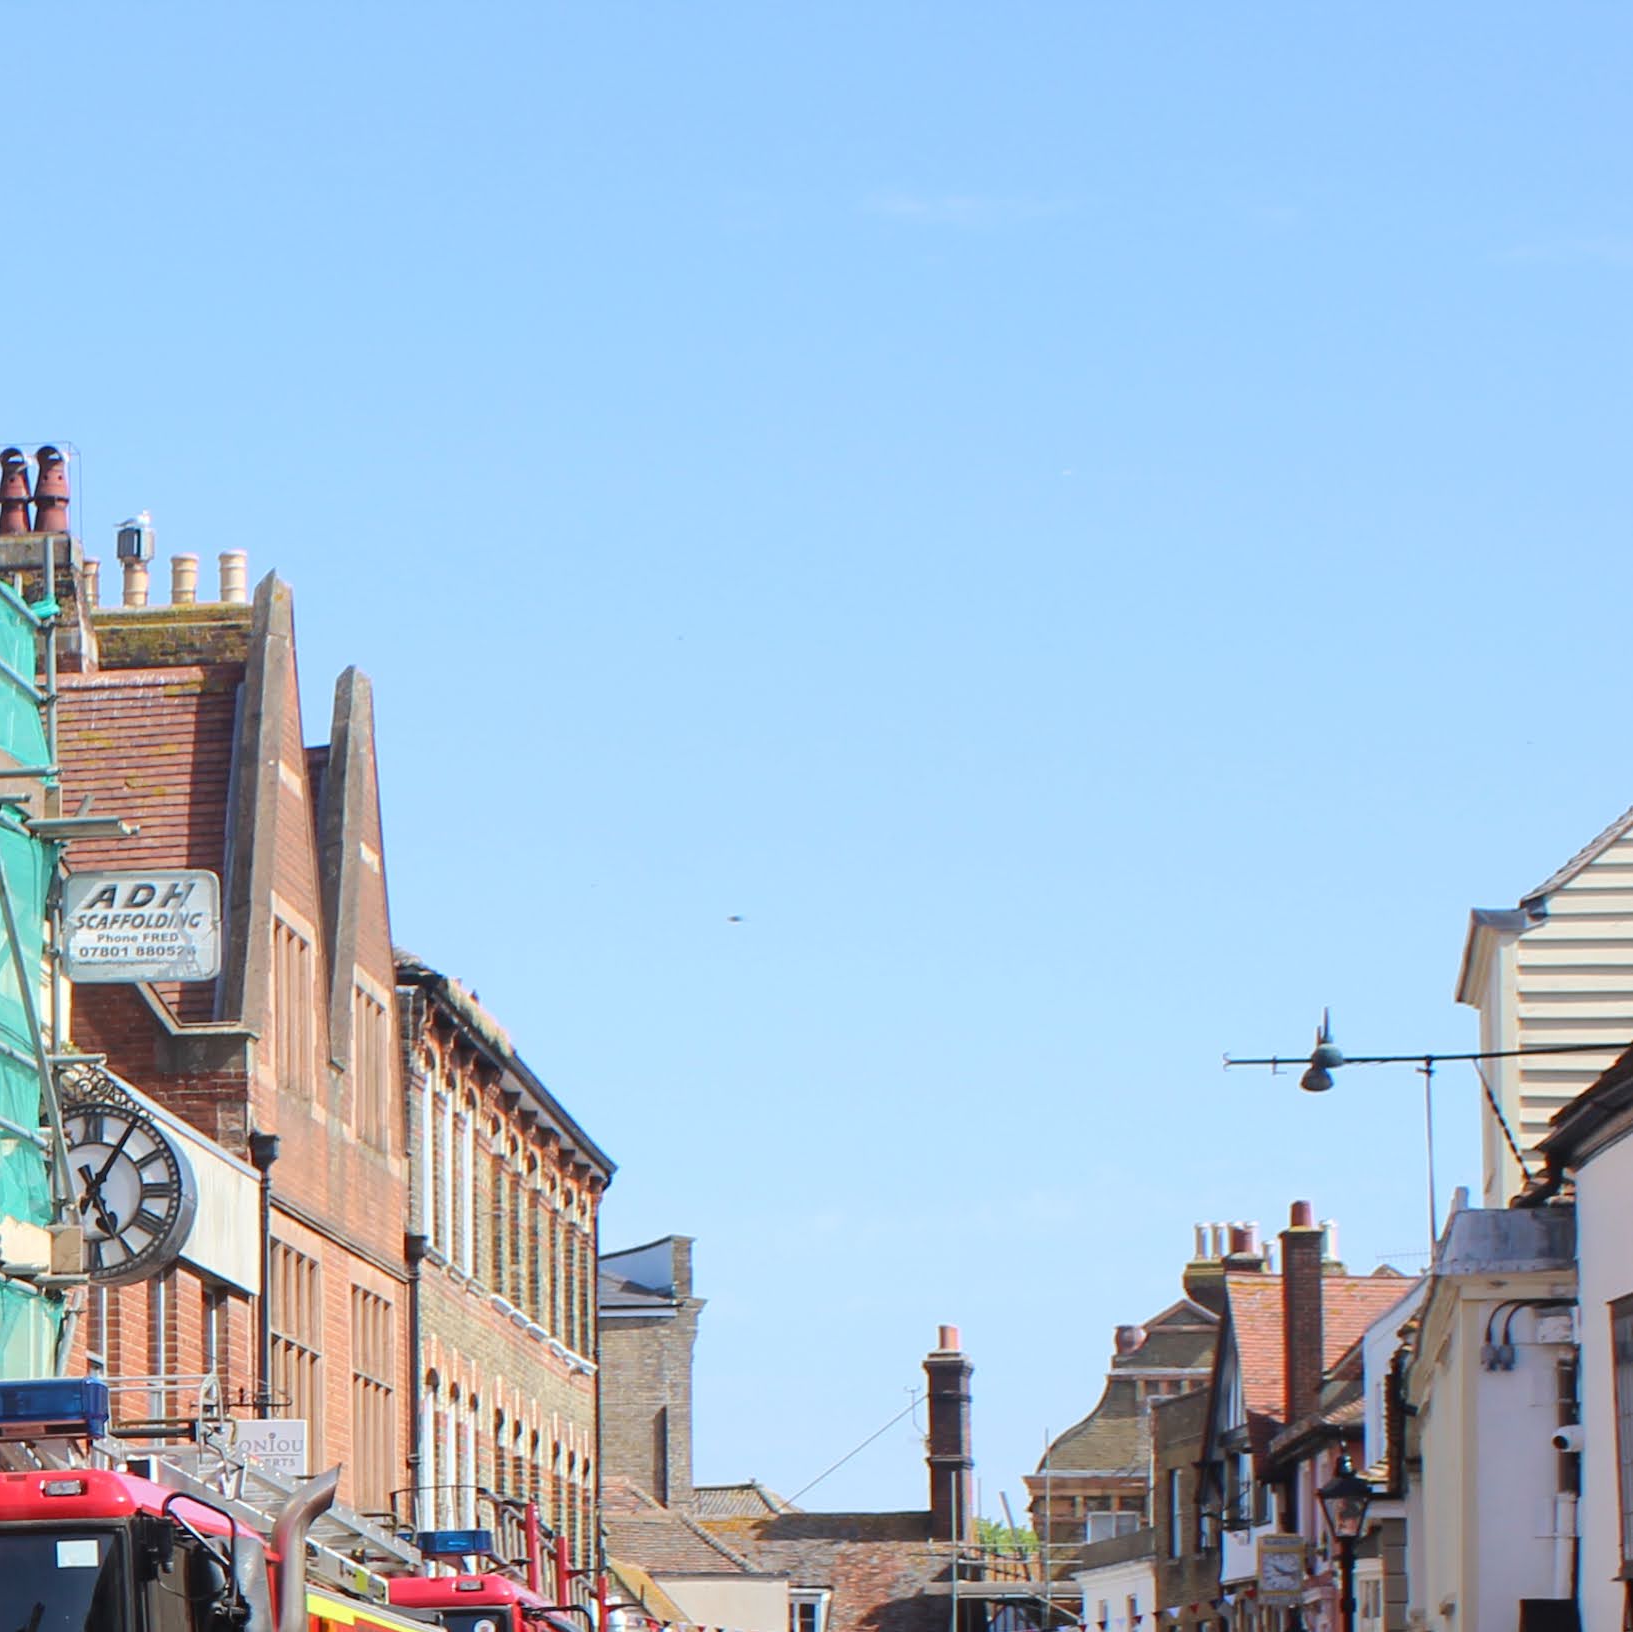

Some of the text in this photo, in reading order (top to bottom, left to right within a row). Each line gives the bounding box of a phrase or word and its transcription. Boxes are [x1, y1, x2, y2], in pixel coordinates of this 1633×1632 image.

[81, 881, 196, 910] ADH
[75, 911, 202, 930] SCAFFOLDING
[96, 932, 179, 944] Phone FRED
[78, 946, 129, 959] 07801
[238, 1432, 303, 1453] ONIOU
